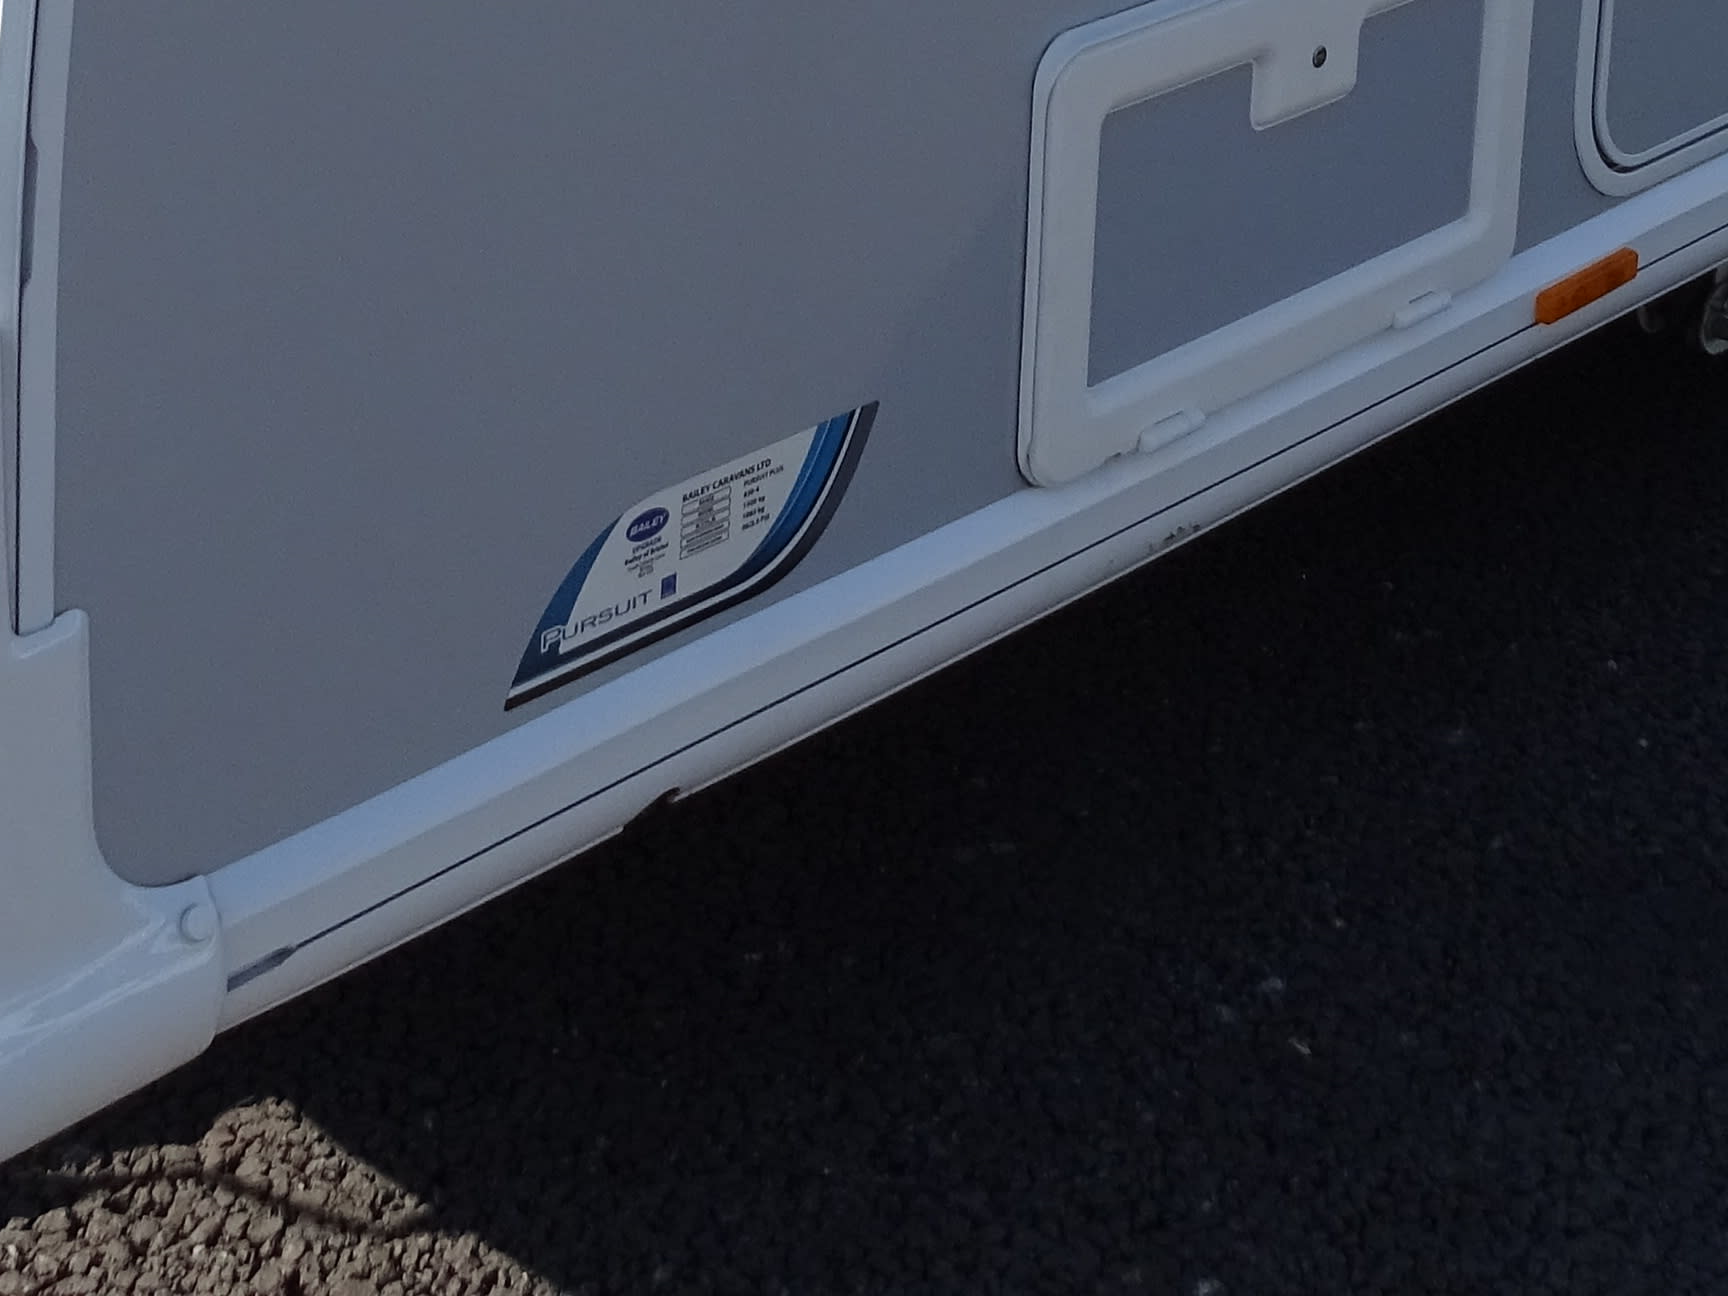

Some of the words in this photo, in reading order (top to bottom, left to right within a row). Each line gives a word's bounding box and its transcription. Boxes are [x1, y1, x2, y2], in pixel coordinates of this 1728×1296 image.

[682, 485, 711, 503] BAILEY
[712, 465, 756, 490] CARAVANS
[756, 458, 772, 472] LTD
[628, 512, 666, 538] BAILEY
[541, 589, 653, 653] PURSUIT
